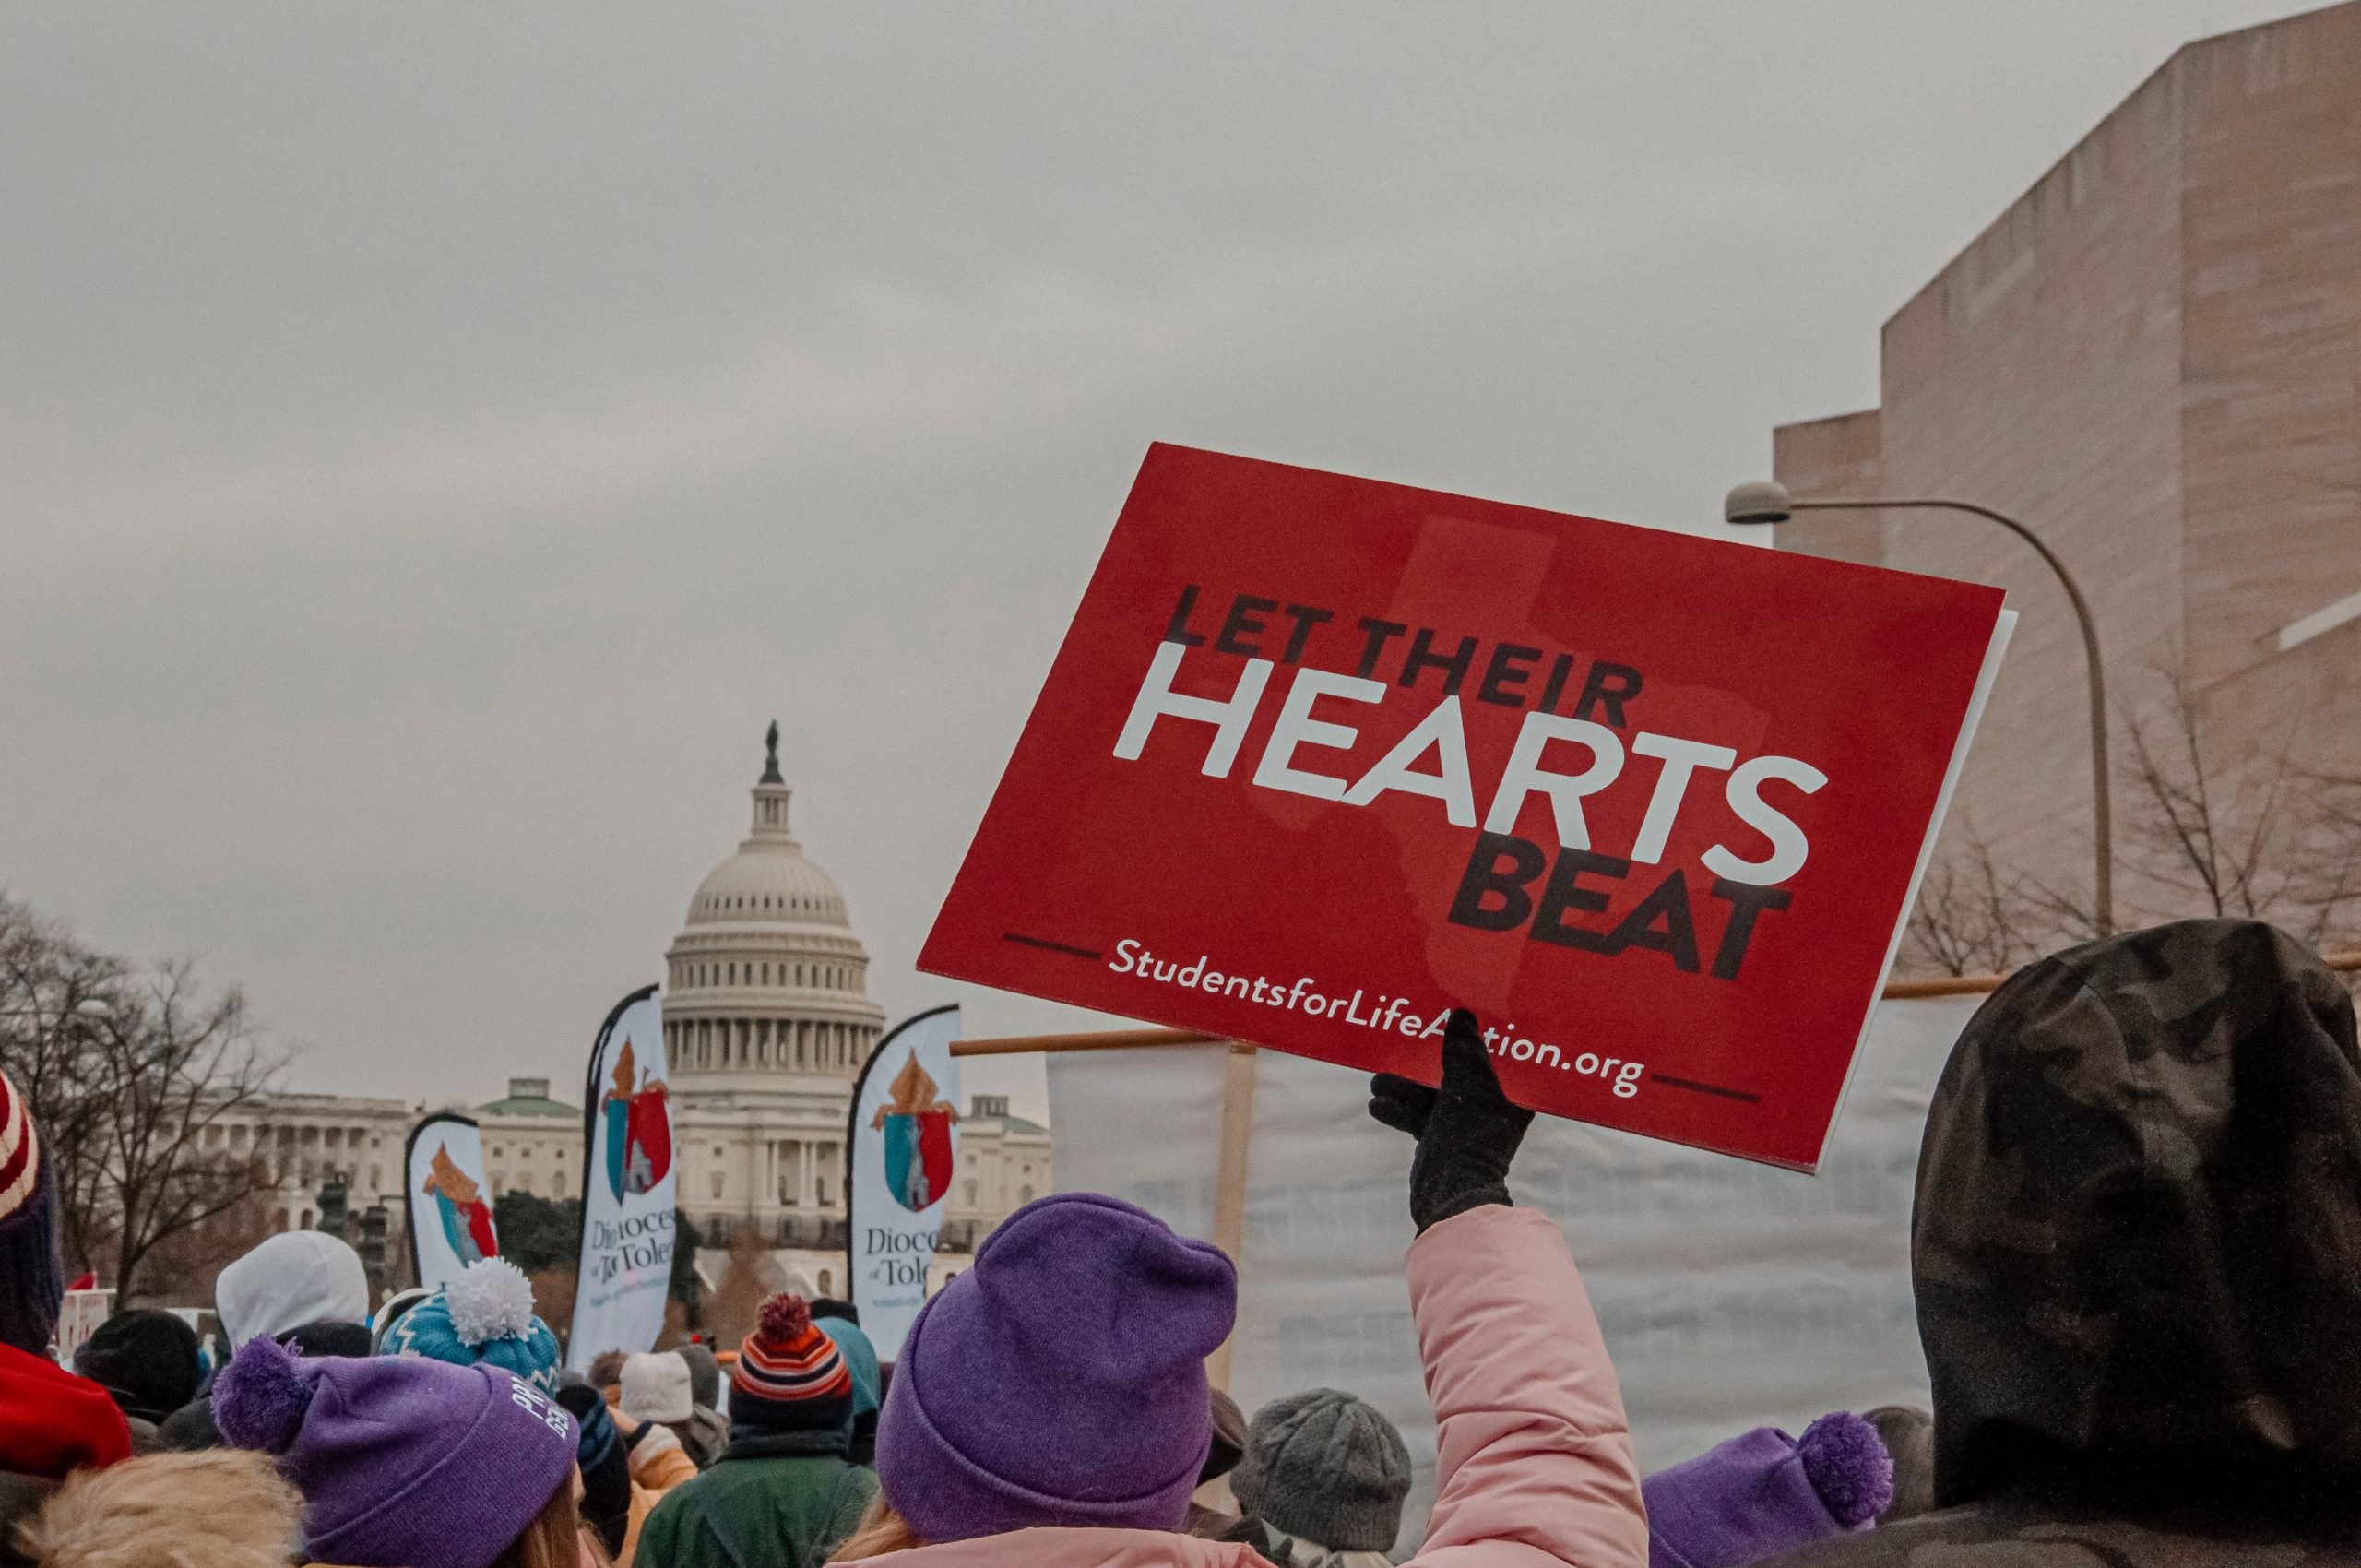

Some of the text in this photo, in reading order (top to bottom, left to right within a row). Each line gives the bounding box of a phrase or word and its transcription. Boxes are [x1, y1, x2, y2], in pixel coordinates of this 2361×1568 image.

[1164, 584, 1643, 730] LET THEIR
[1112, 640, 1829, 886] HEARTS
[1448, 830, 1795, 981] BEAT
[1109, 939, 1644, 1099] StudentsforLifeAtion.org
